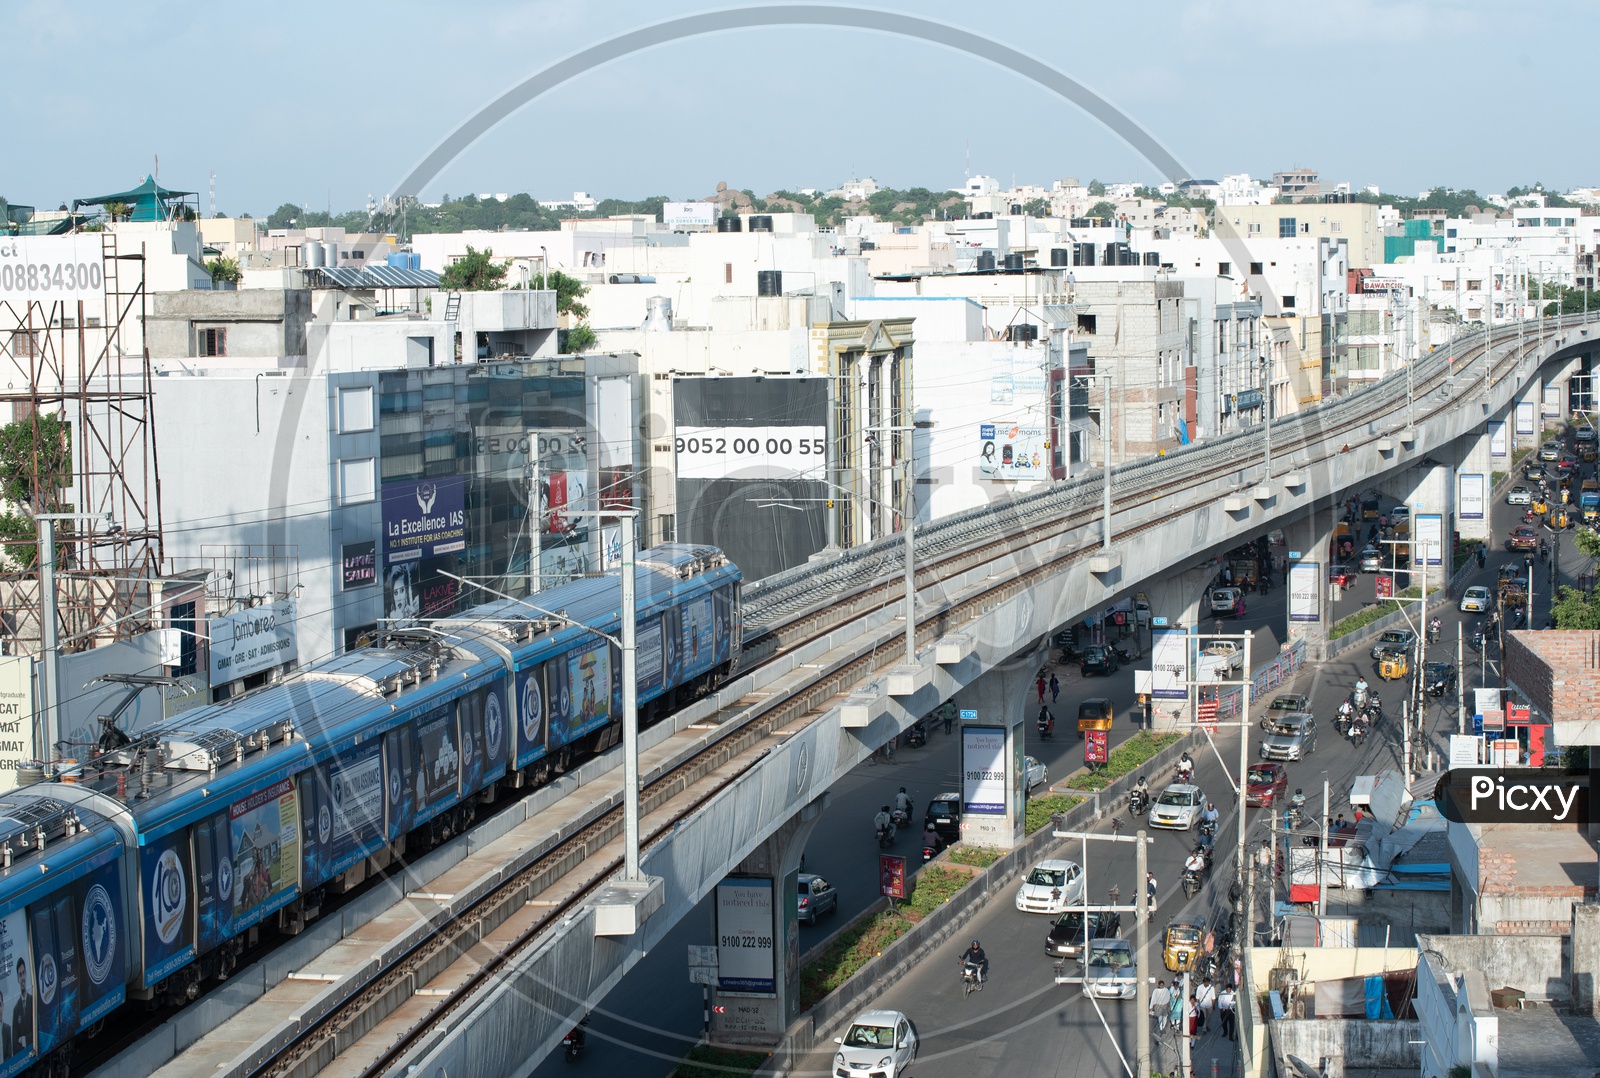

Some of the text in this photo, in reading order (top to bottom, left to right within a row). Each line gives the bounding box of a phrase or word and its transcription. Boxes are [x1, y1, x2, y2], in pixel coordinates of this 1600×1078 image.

[0, 262, 102, 292] 08834300
[676, 438, 825, 455] 9052 00 00 55
[389, 510, 464, 536] La Excellence IAS
[401, 535, 423, 547] INSTITUTE
[424, 534, 434, 543] FOR
[442, 528, 464, 540] COACHING
[423, 579, 455, 600] LAKMÉ
[231, 615, 276, 652] Jamboree
[217, 655, 232, 670] GMAT
[234, 652, 246, 665] GRE
[248, 648, 258, 660] SAT
[260, 638, 290, 656] ADMISSIONS
[1154, 664, 1166, 672] 9100
[0, 703, 18, 715] CAT
[0, 741, 24, 752] MAT
[360, 767, 380, 792] ASSURANCE
[967, 771, 1005, 781] 9100 222 999
[233, 780, 290, 817] HOUSE HOLDER'S INSURANCE
[723, 898, 770, 908] noticed this
[734, 890, 764, 900] You have
[722, 936, 772, 949] 9100 222 999
[60, 946, 74, 962] Trusted
